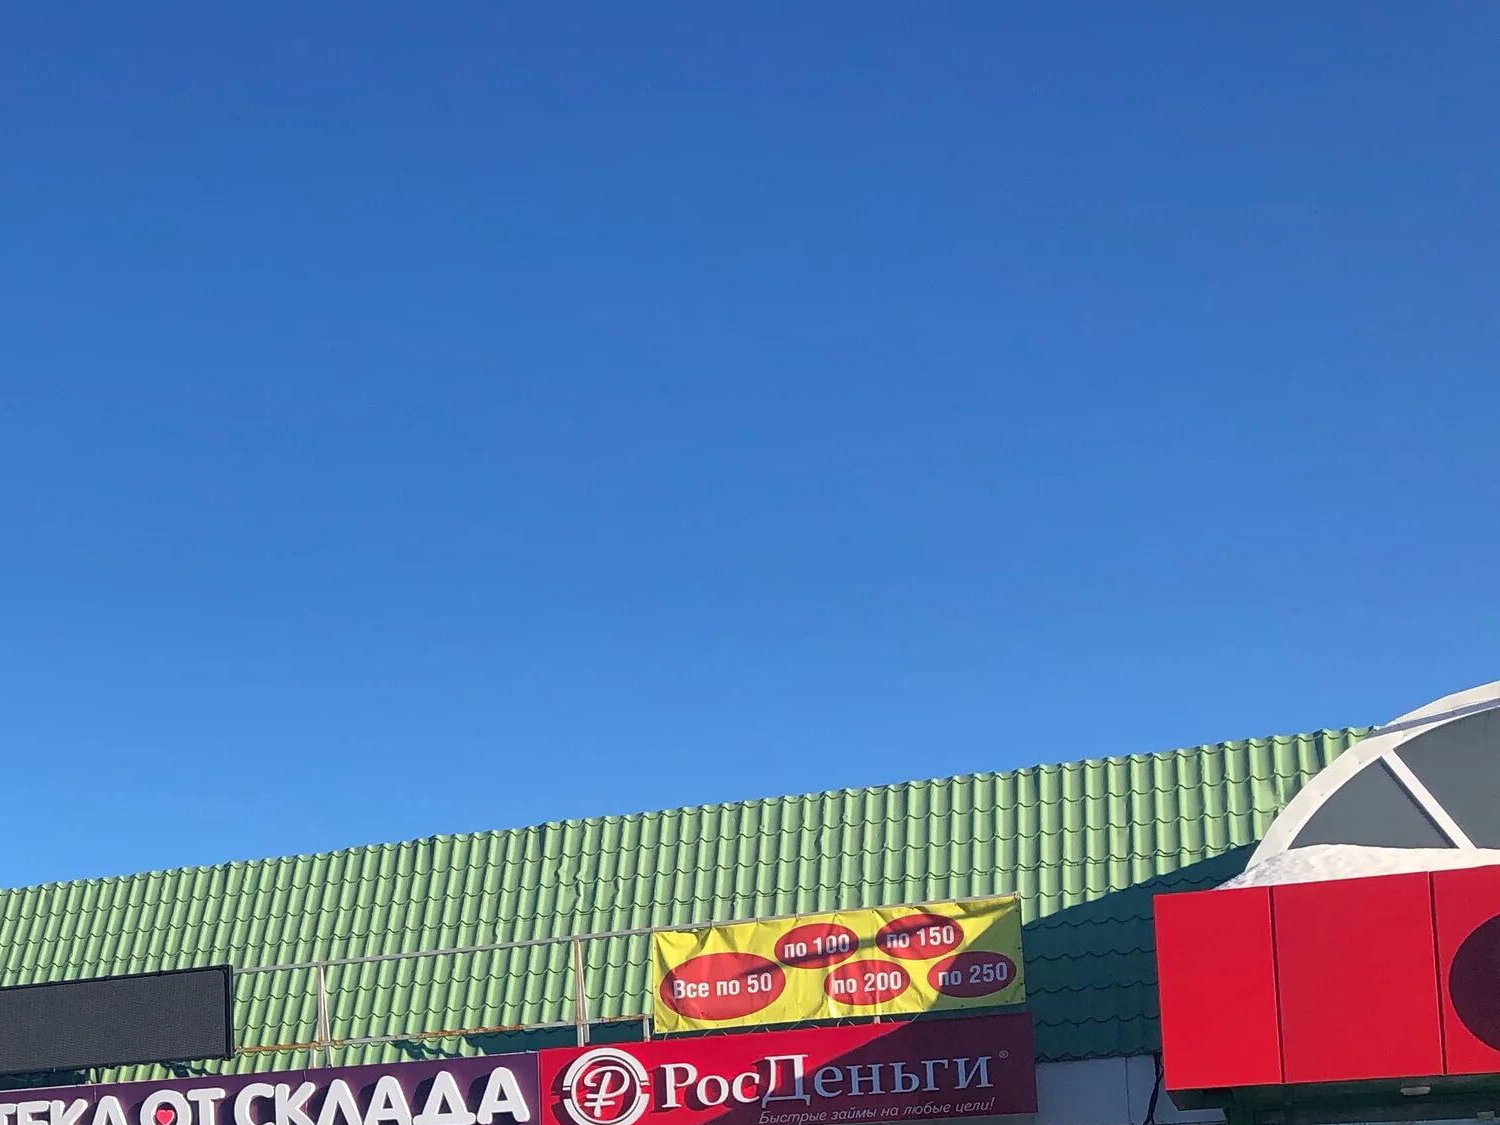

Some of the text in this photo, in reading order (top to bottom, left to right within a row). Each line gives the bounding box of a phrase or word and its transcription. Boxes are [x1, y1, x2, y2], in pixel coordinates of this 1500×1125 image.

[783, 933, 851, 959] по 100
[886, 925, 955, 949] по 150
[673, 972, 773, 1000] Все по 50
[833, 970, 902, 996] по 200
[937, 961, 1008, 987] по 250
[660, 1053, 994, 1109] РосДеньги
[758, 1096, 996, 1125] Быстрые займы на любые цели!
